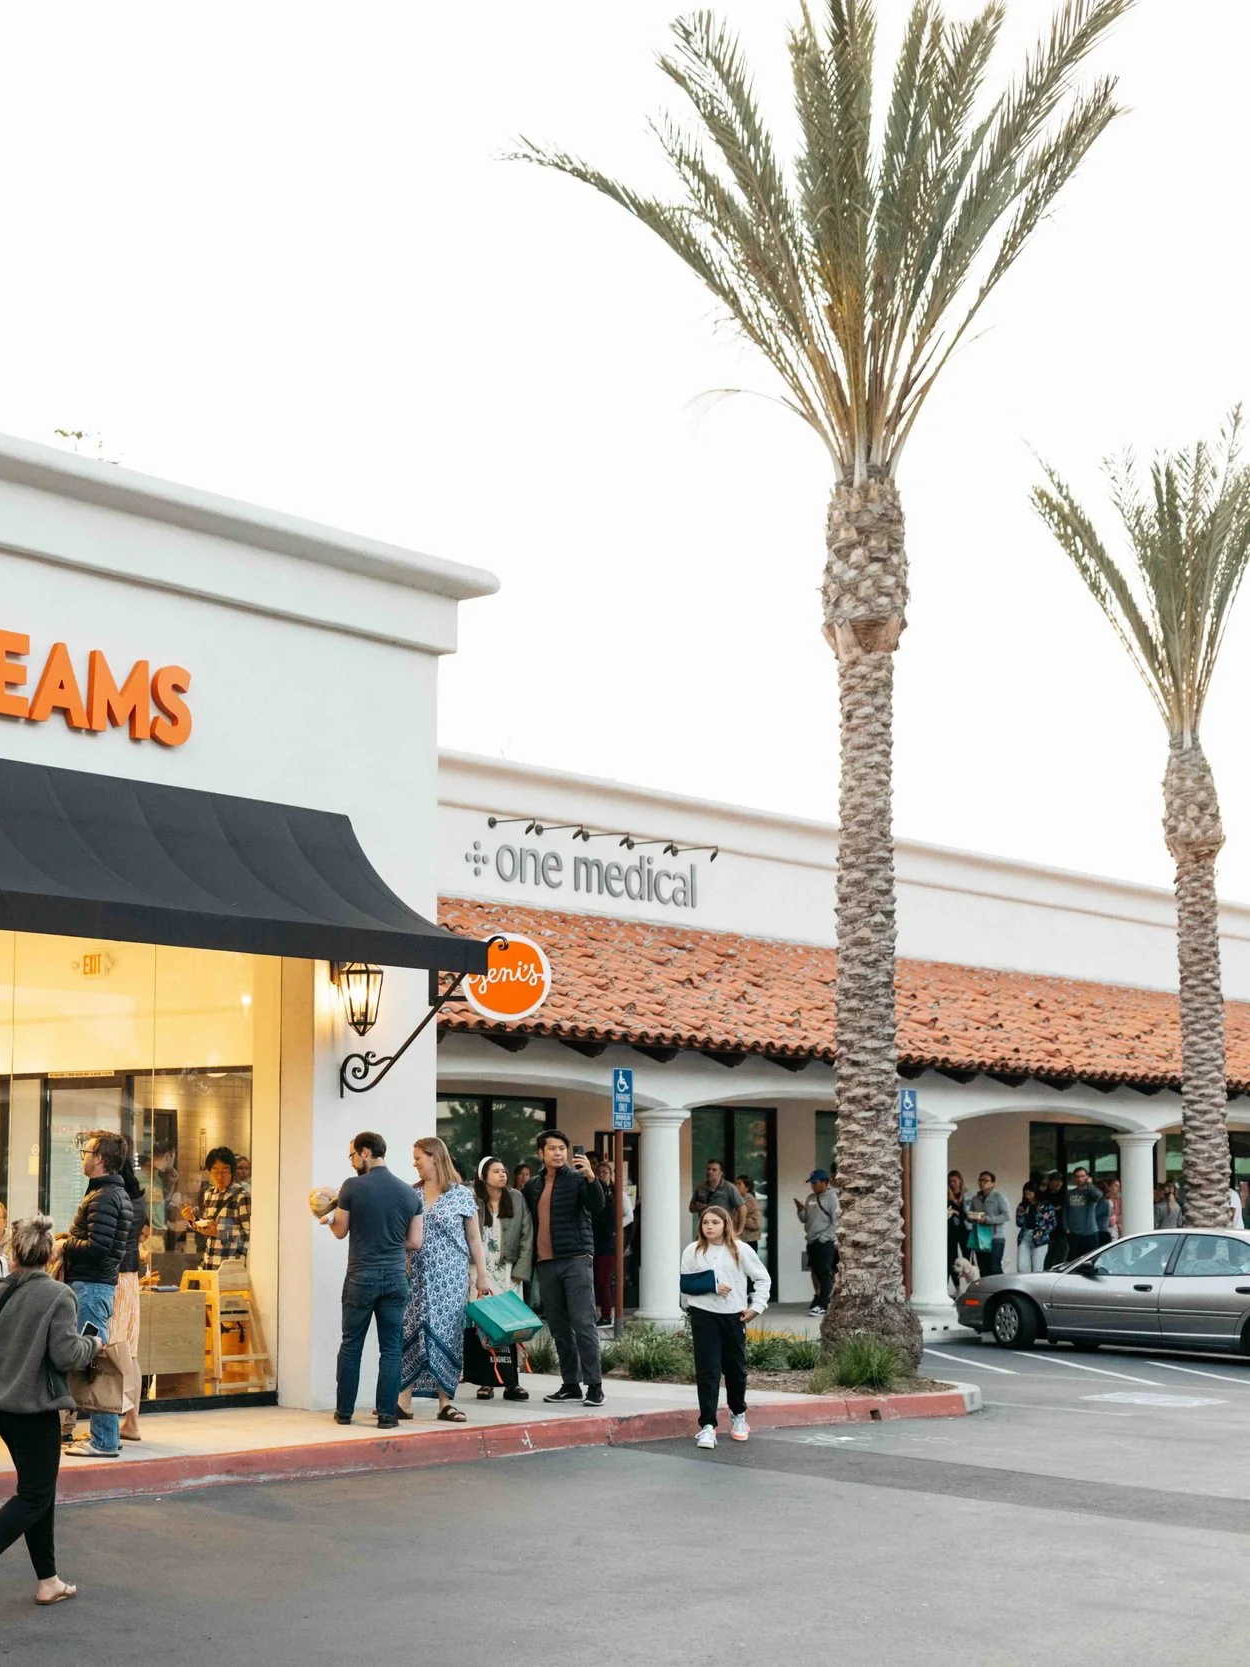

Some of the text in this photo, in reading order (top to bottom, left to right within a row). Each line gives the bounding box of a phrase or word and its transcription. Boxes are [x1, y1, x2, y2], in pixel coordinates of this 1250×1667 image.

[495, 844, 698, 908] one medical
[83, 953, 102, 975] EXIT
